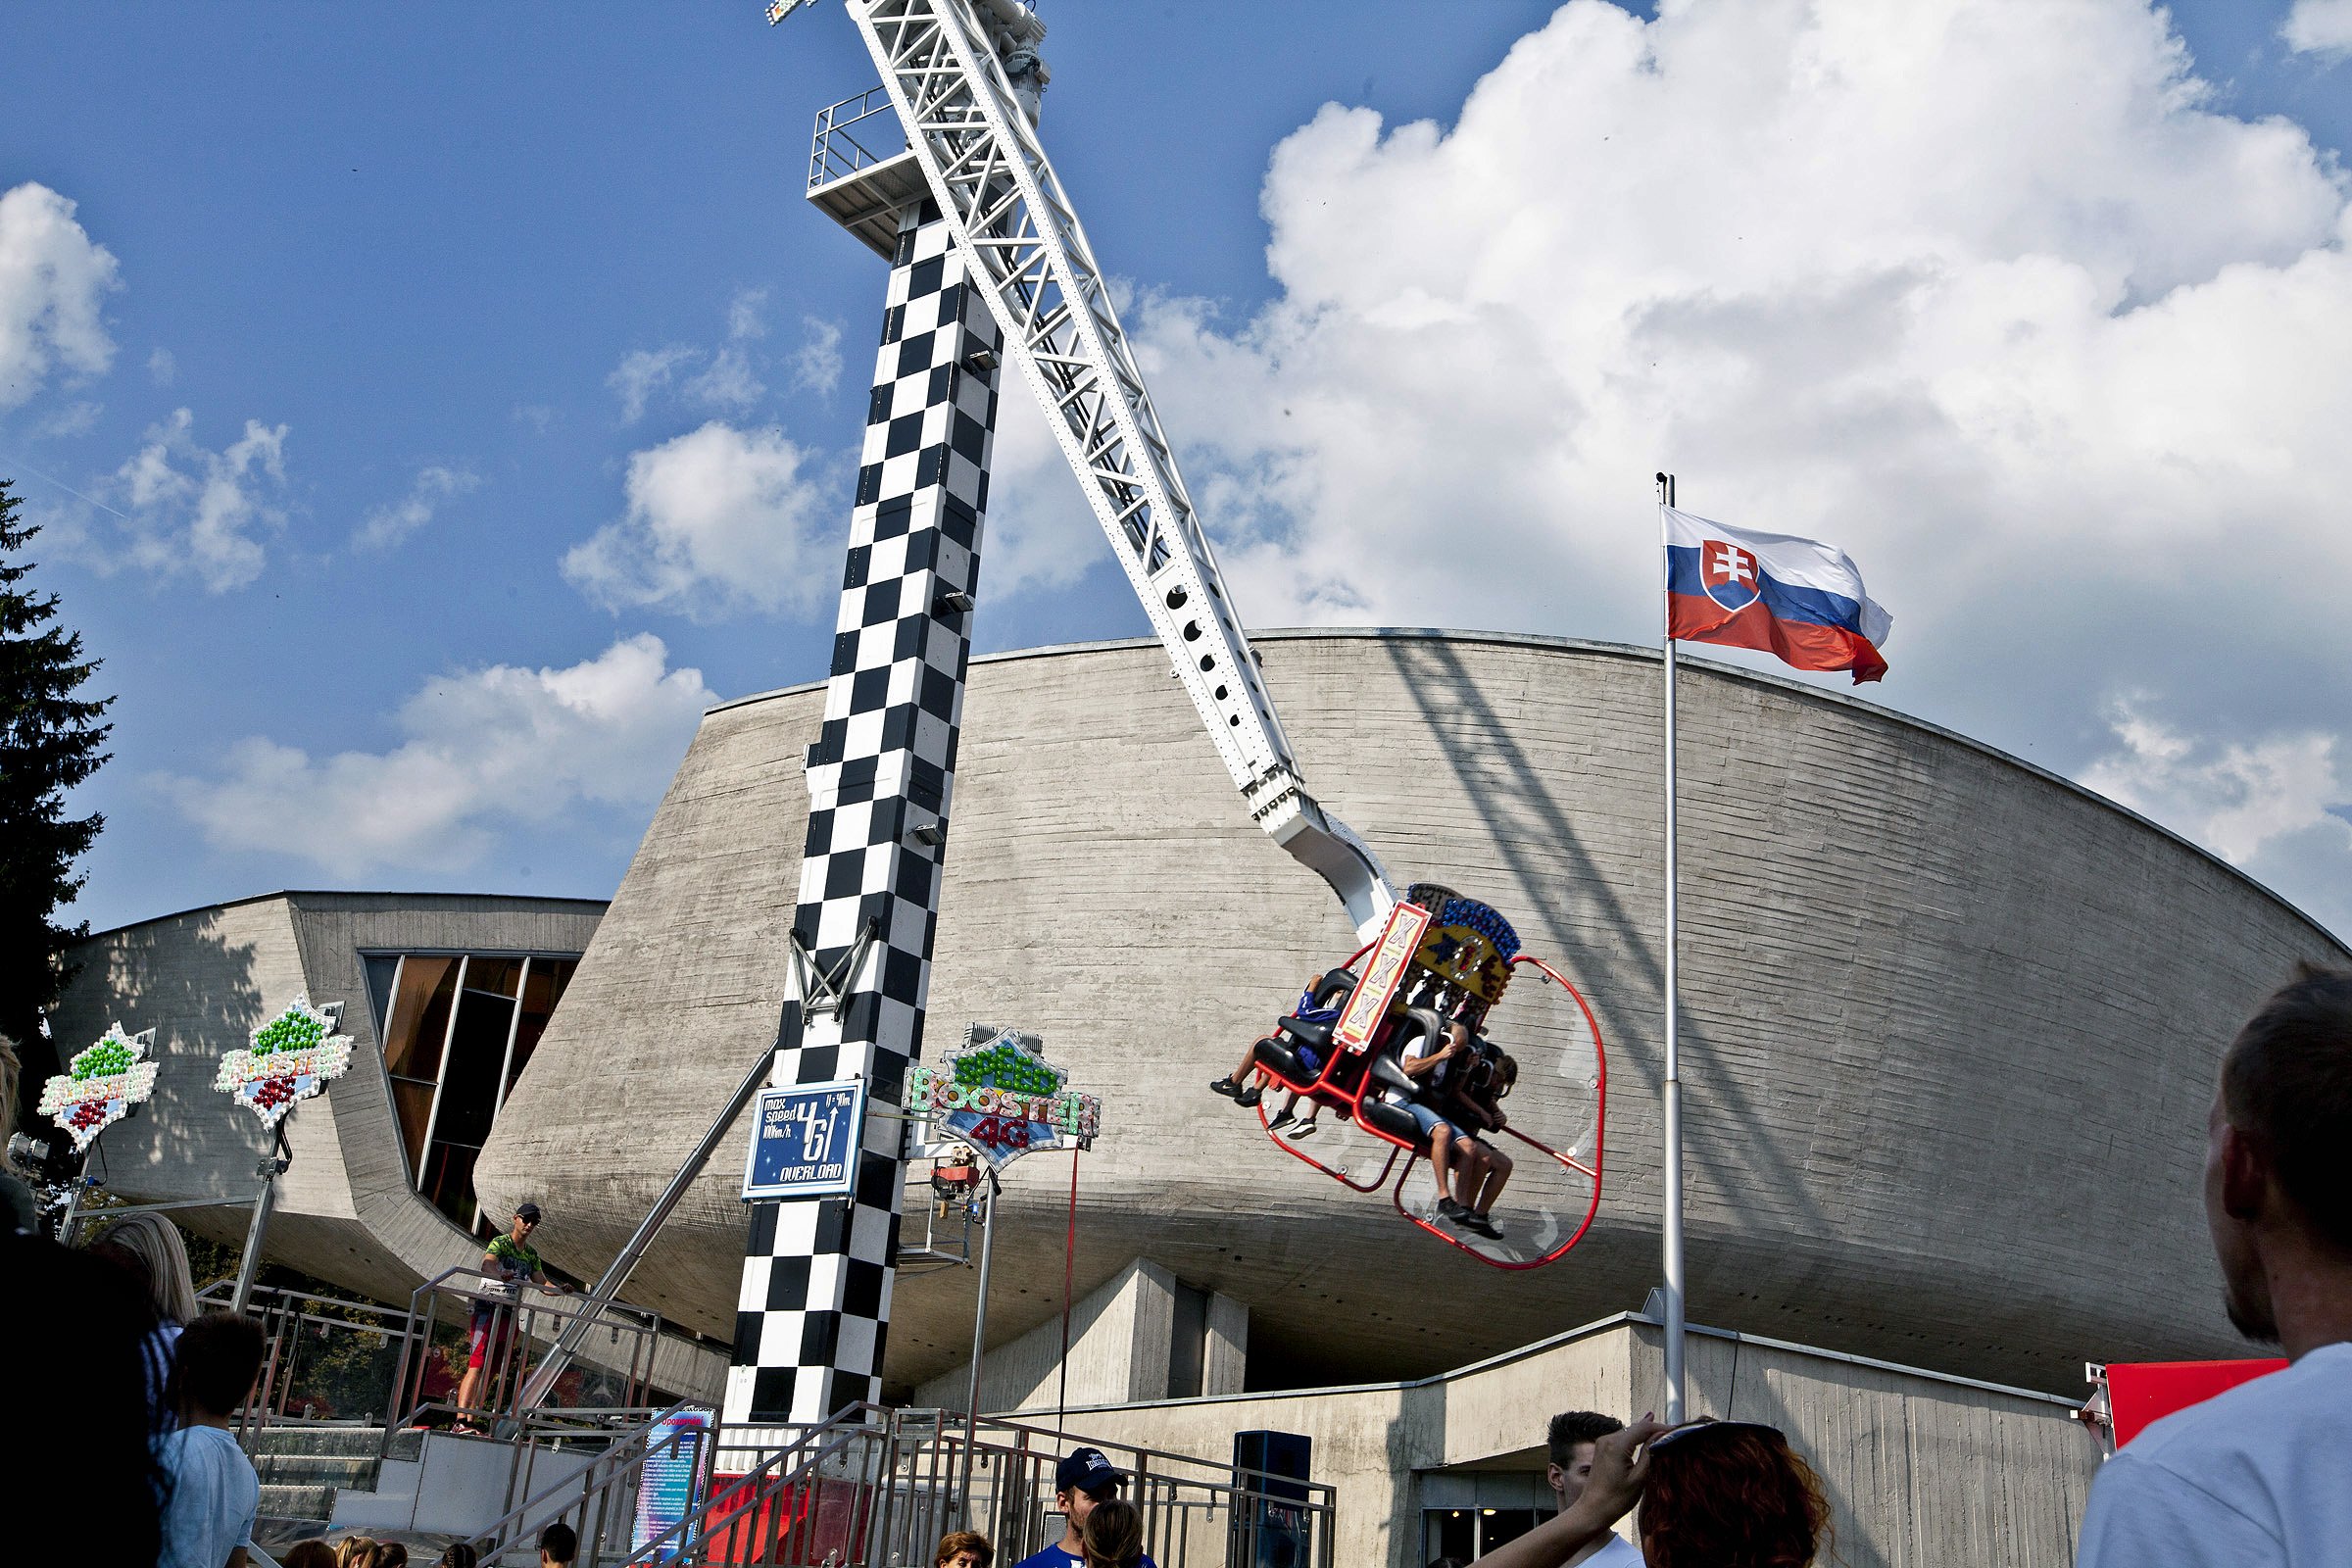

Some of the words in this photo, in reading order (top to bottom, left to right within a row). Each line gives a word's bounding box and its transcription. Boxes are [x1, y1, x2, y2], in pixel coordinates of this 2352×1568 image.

[1388, 913, 1418, 949] X
[1369, 953, 1398, 988] X
[1349, 993, 1379, 1029] X
[955, 1047, 1057, 1095] SPEED
[764, 1098, 786, 1111] max
[765, 1103, 797, 1124] speed
[910, 1067, 1097, 1137] BOOSTER
[969, 1116, 1030, 1149] 4G
[780, 1163, 843, 1181] OVERLOAD
